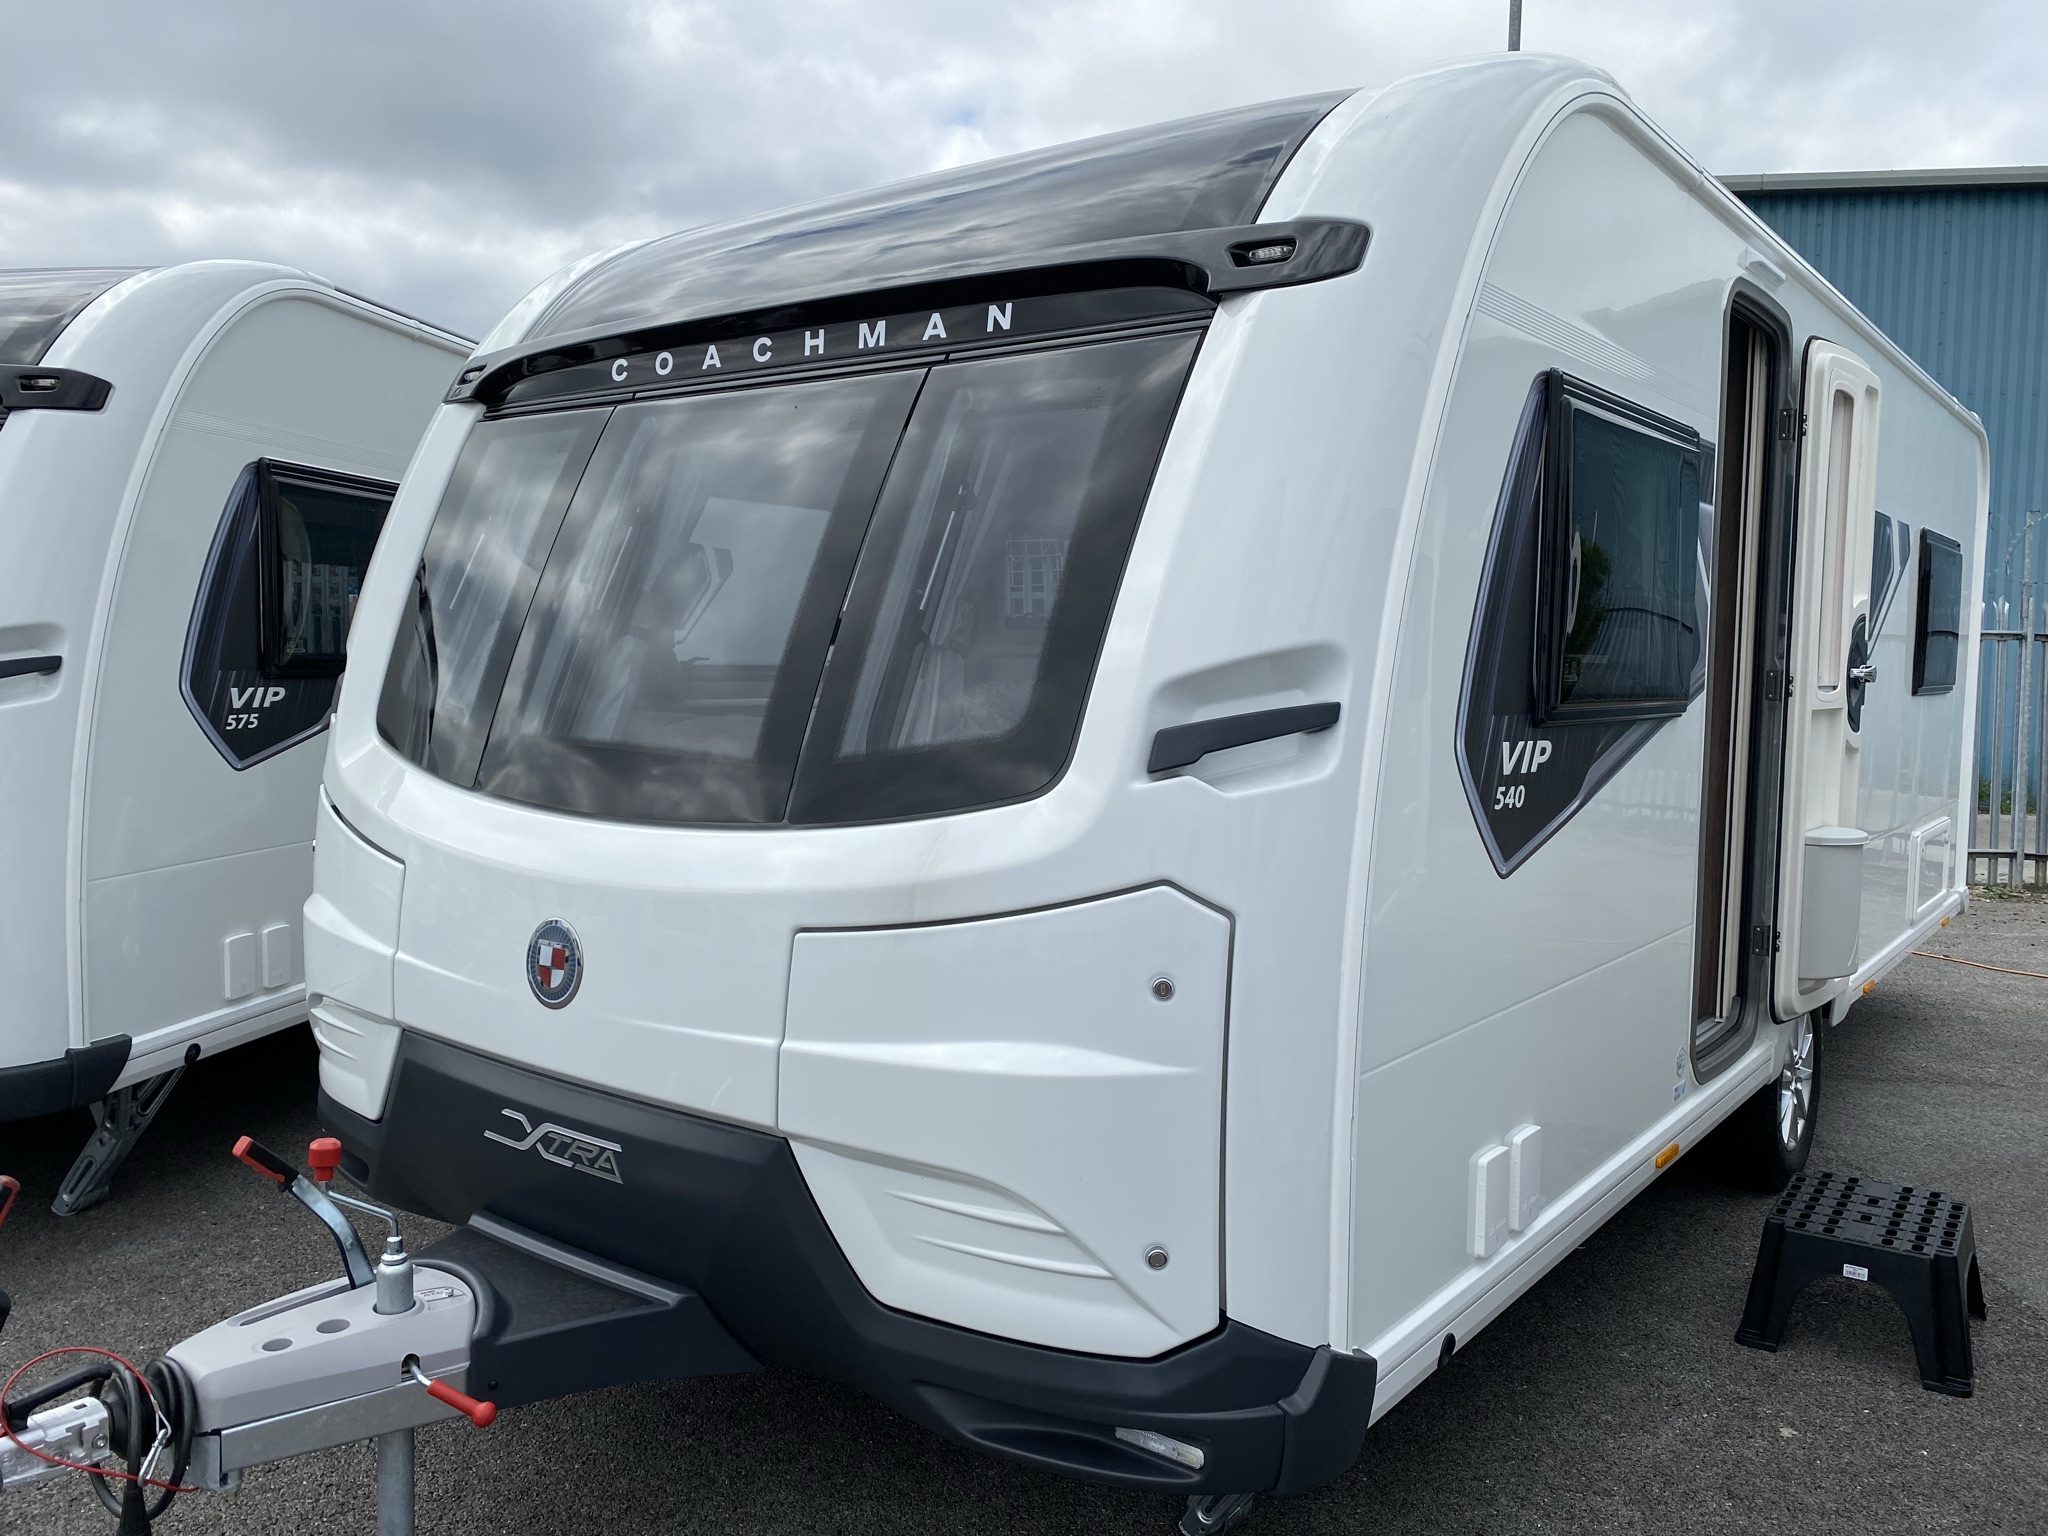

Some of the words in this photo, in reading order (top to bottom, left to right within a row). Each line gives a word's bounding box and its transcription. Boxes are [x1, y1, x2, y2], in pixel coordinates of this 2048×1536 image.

[611, 302, 1013, 382] COACHMAN
[230, 686, 286, 709] VIP
[225, 713, 259, 730] 575
[1502, 740, 1552, 776] VIP
[1494, 784, 1526, 810] 540
[483, 1108, 624, 1184] XTRA
